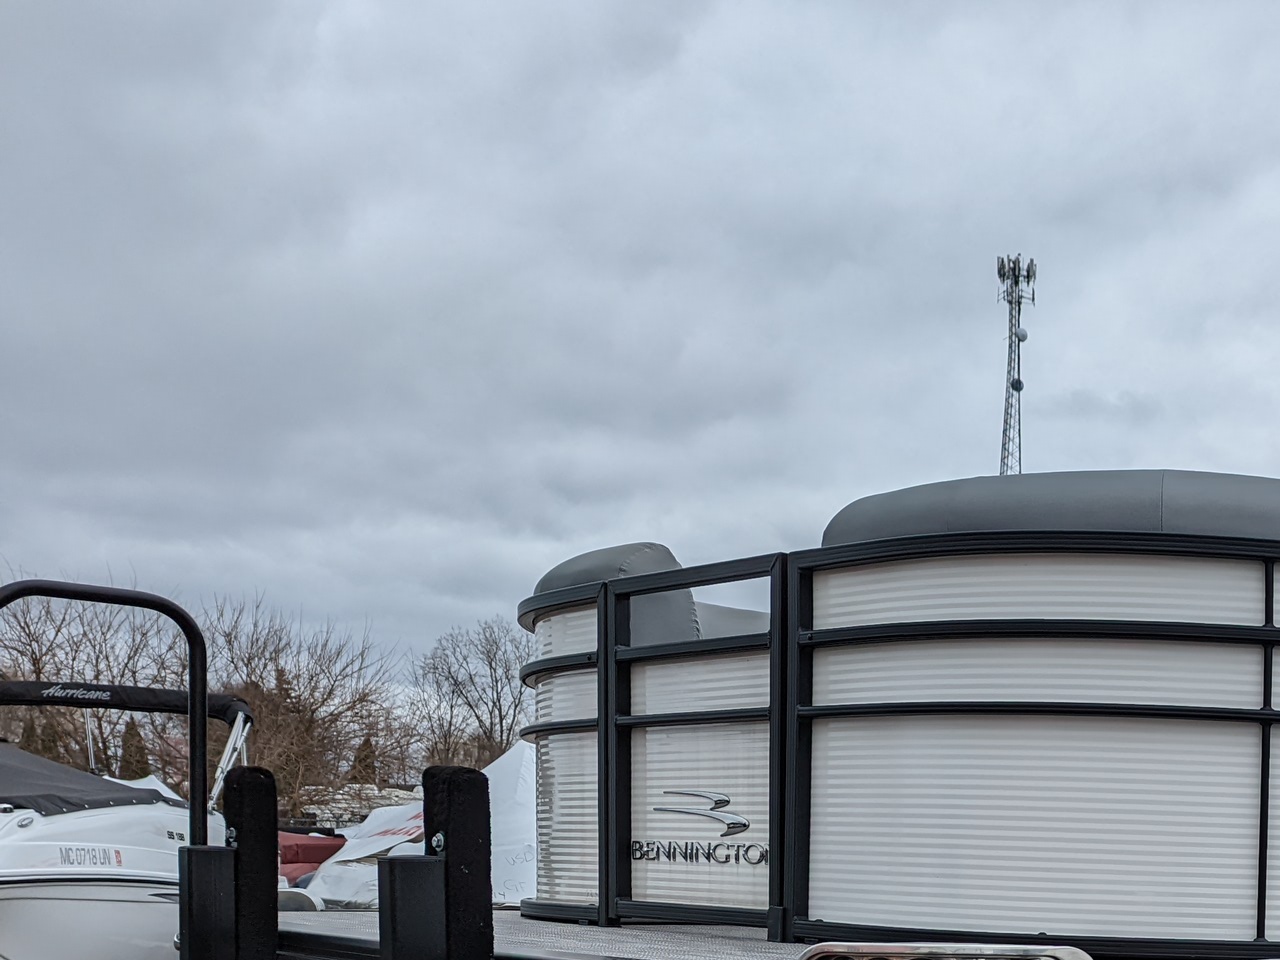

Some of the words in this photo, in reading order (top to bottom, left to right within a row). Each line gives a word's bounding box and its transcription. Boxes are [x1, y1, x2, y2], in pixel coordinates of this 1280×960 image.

[41, 684, 111, 700] Hurricane
[59, 847, 75, 865] MC
[75, 848, 98, 866] 0718
[632, 840, 769, 865] BENNINGTO
